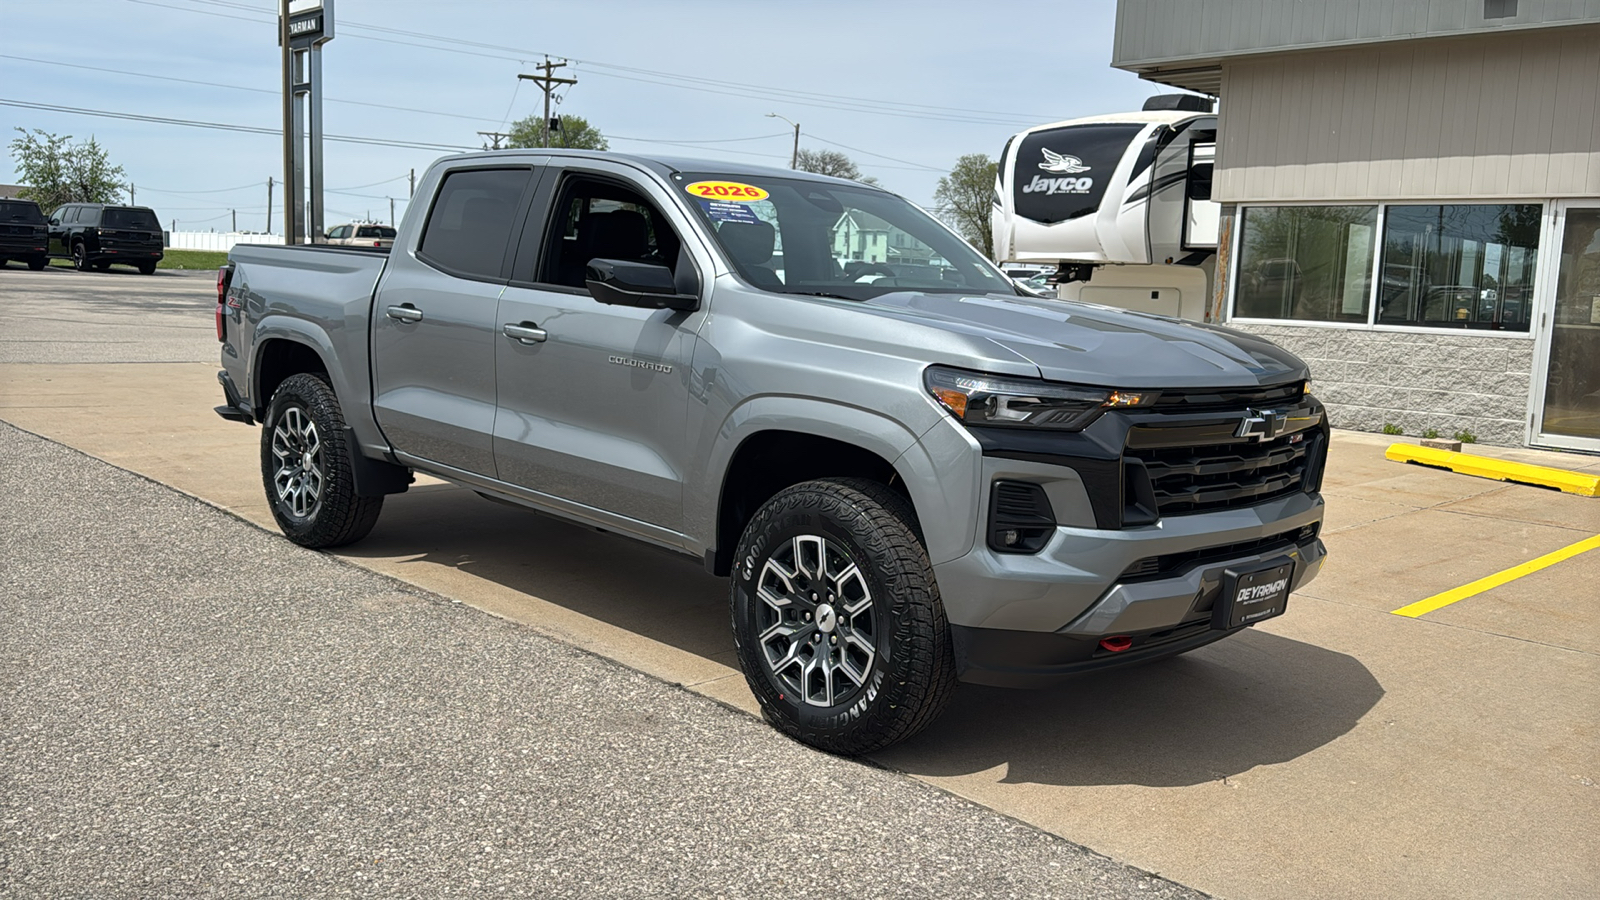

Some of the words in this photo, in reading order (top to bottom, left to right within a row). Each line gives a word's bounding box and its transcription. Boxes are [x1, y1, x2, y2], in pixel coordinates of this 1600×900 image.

[289, 19, 316, 35] YARMAN
[697, 185, 760, 197] 2026
[1023, 175, 1093, 195] Jayco
[608, 355, 672, 374] COLORADO
[742, 513, 813, 581] GOODYEAR
[1236, 577, 1288, 602] DEYARMAN
